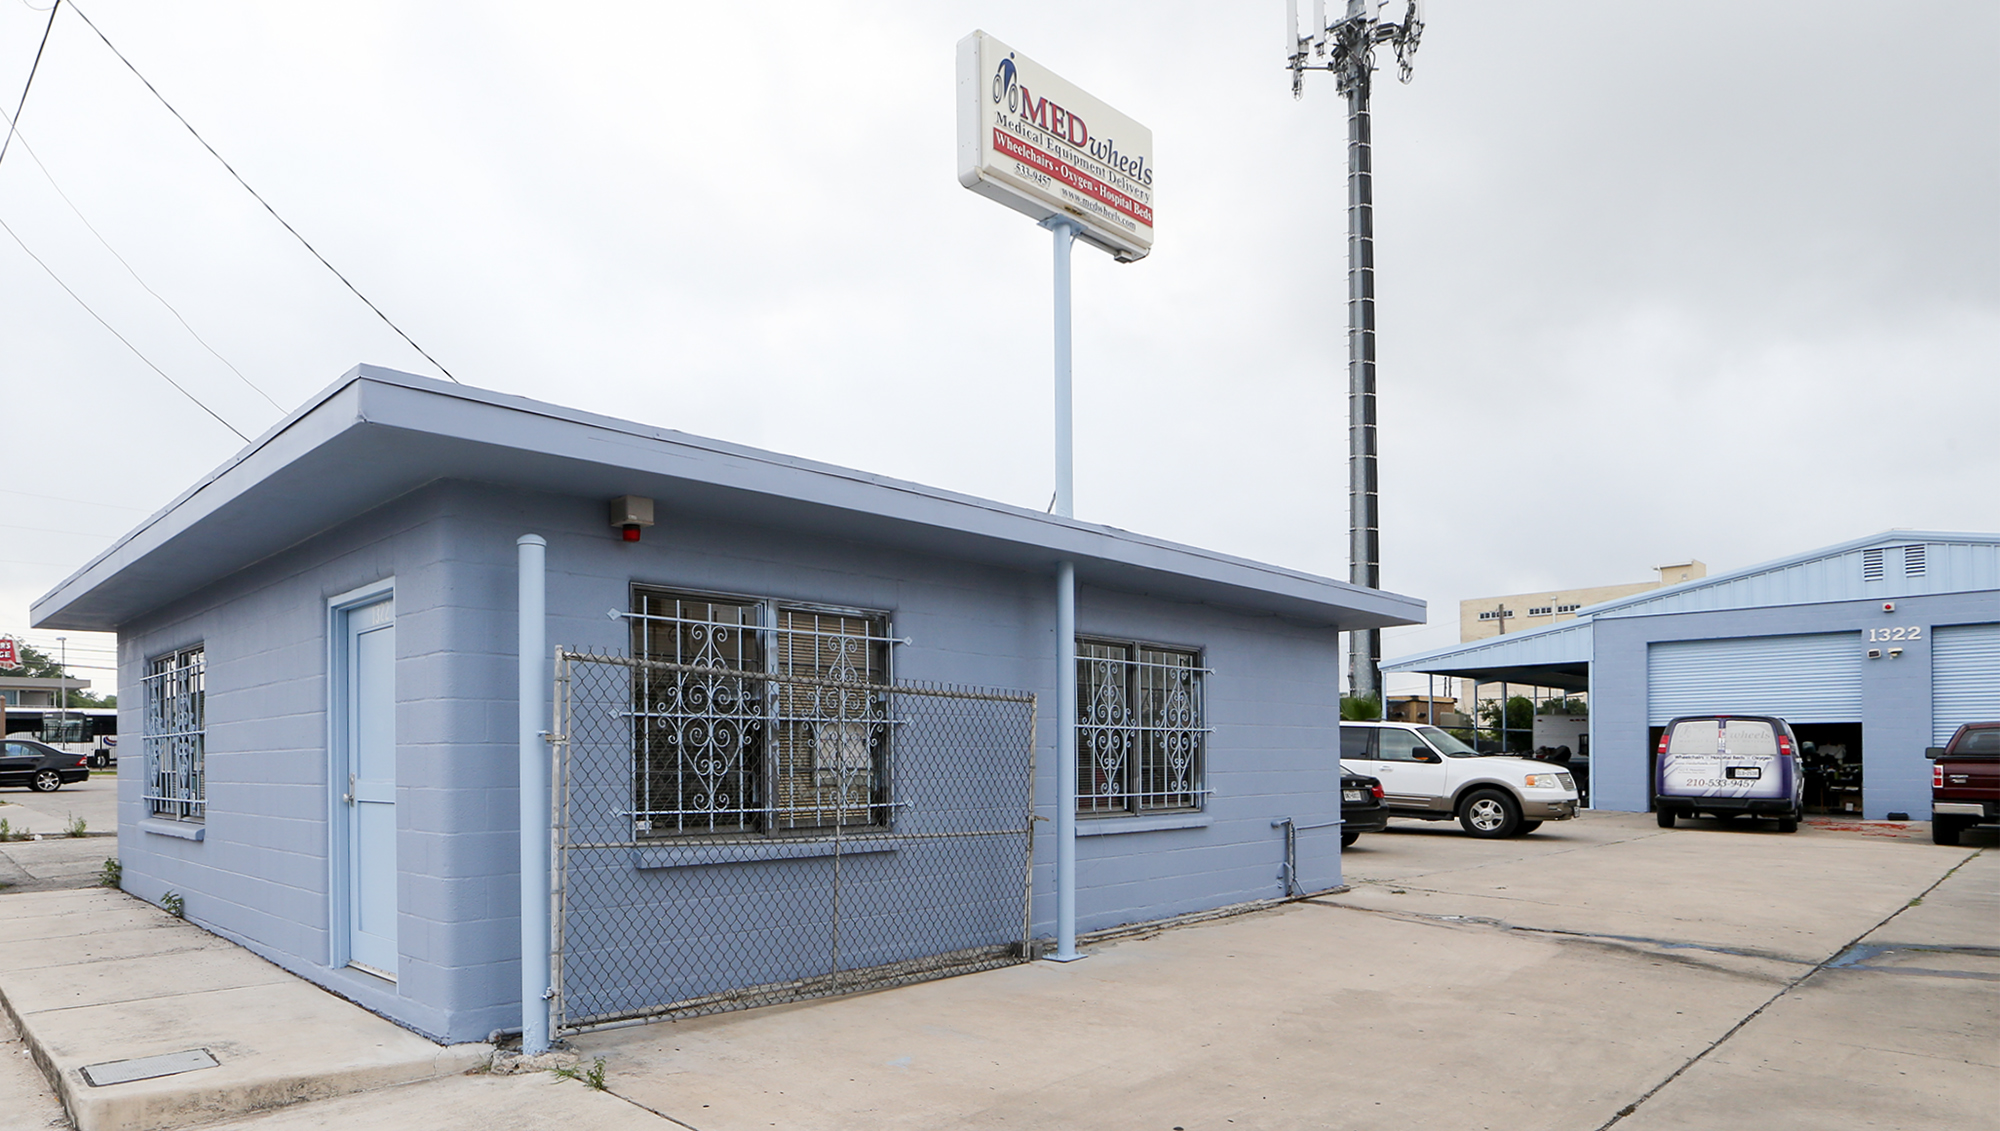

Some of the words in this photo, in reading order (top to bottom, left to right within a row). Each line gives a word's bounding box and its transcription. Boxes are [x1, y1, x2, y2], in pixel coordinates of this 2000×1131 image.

[995, 111, 1043, 145] Medical
[1046, 137, 1106, 178] Equipment
[1108, 170, 1150, 203] Delivery
[995, 131, 1054, 171] Wheelchairs
[1061, 165, 1093, 191] Oxygen
[1100, 185, 1133, 212] Hospital
[1134, 202, 1152, 221] Beds
[1015, 163, 1052, 189] 533-9457
[1061, 188, 1136, 231] www.medwheels.com
[1869, 626, 1922, 642] 1322
[1686, 778, 1757, 788] 210-533-9457
